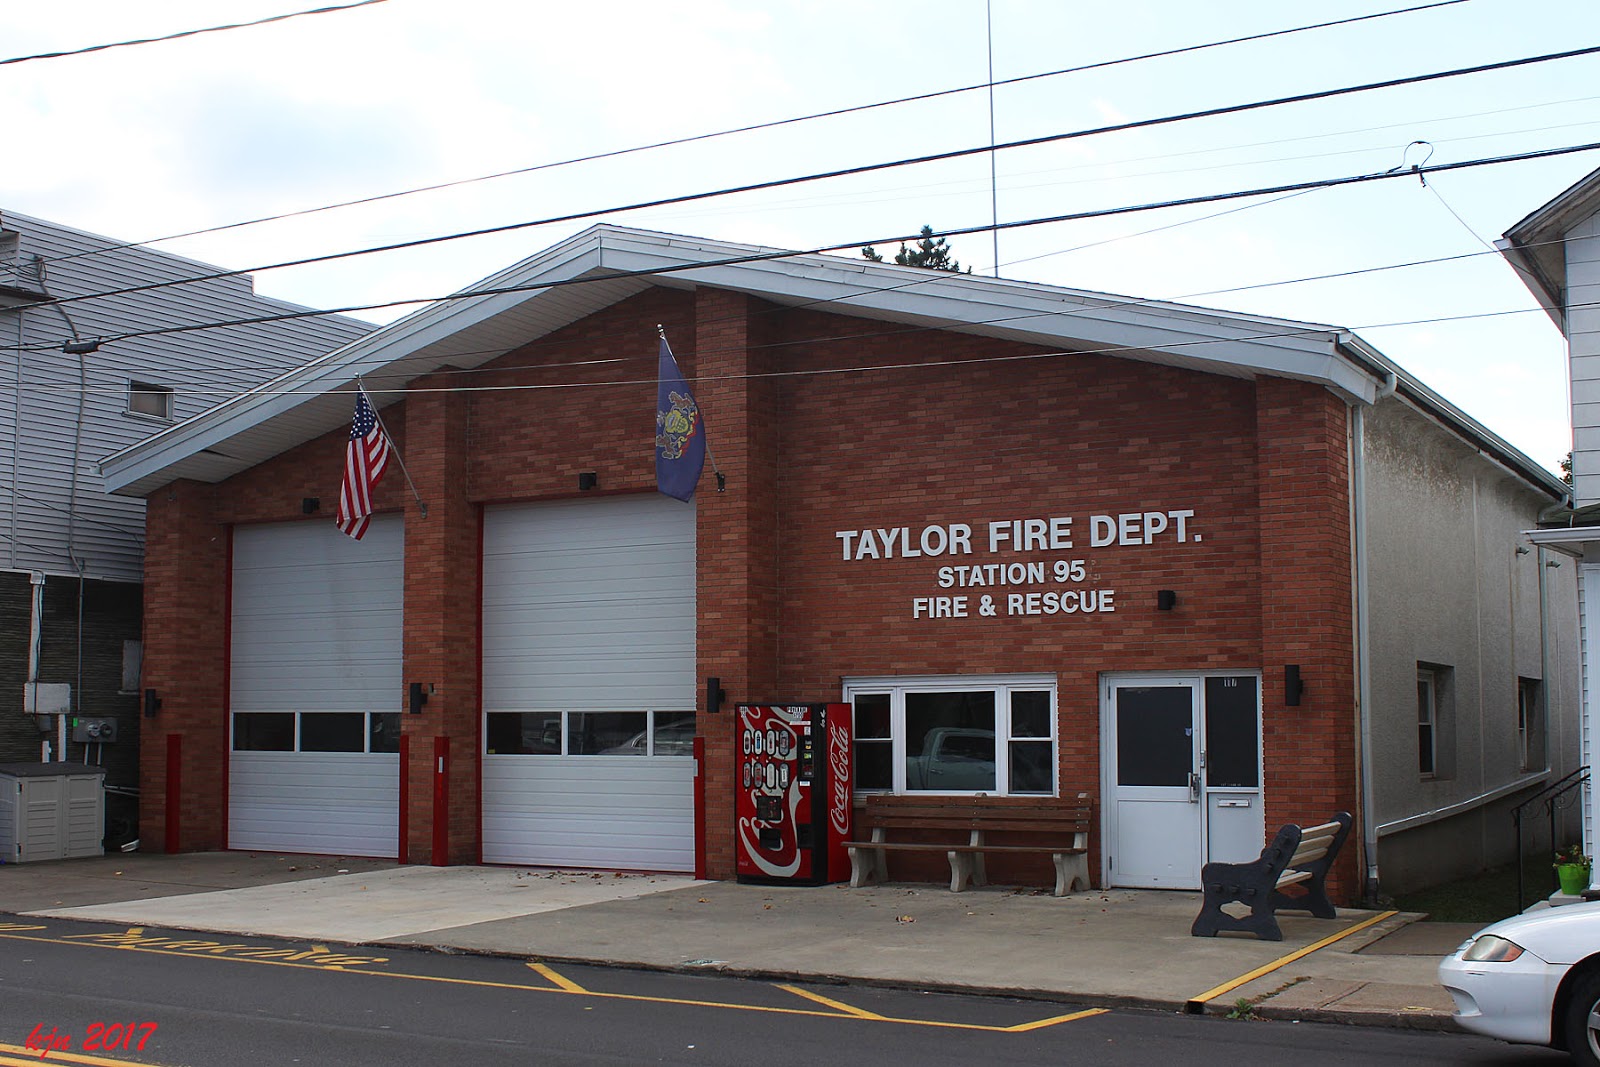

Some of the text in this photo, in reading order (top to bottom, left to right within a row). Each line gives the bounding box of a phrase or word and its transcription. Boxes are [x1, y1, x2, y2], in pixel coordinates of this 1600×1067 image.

[835, 509, 1202, 561] TAYLOR FIRE DEPT.
[938, 559, 1086, 588] STATION 95
[913, 589, 1115, 619] FIRE & RESCUE
[830, 719, 849, 835] Coca-Cola
